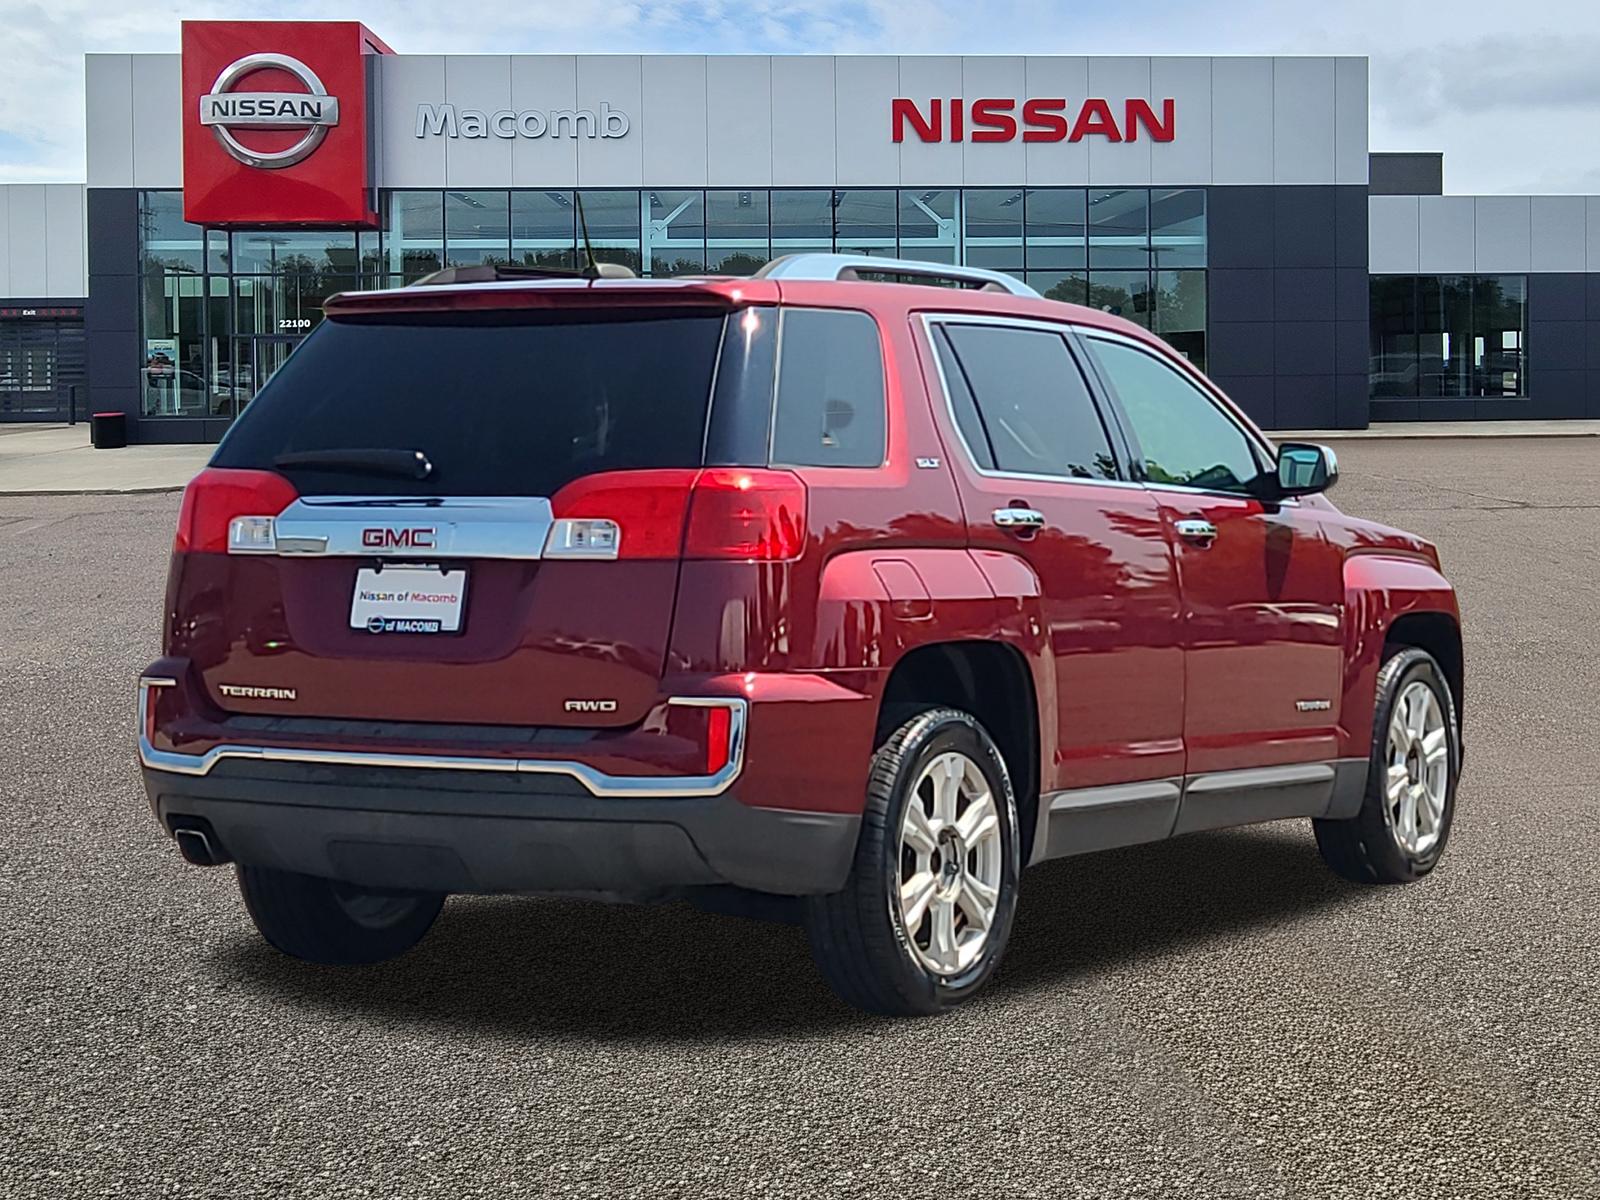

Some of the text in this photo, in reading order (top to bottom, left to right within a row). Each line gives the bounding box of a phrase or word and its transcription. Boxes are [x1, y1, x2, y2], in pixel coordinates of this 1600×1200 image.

[212, 100, 322, 117] NISSAN
[415, 102, 630, 139] Macomb
[892, 98, 1176, 143] NISSAN
[279, 319, 311, 328] 22100
[362, 526, 438, 549] GMC
[360, 591, 458, 604] Nissan of Macomb
[219, 684, 297, 700] TERRAIN
[564, 700, 617, 711] AWD
